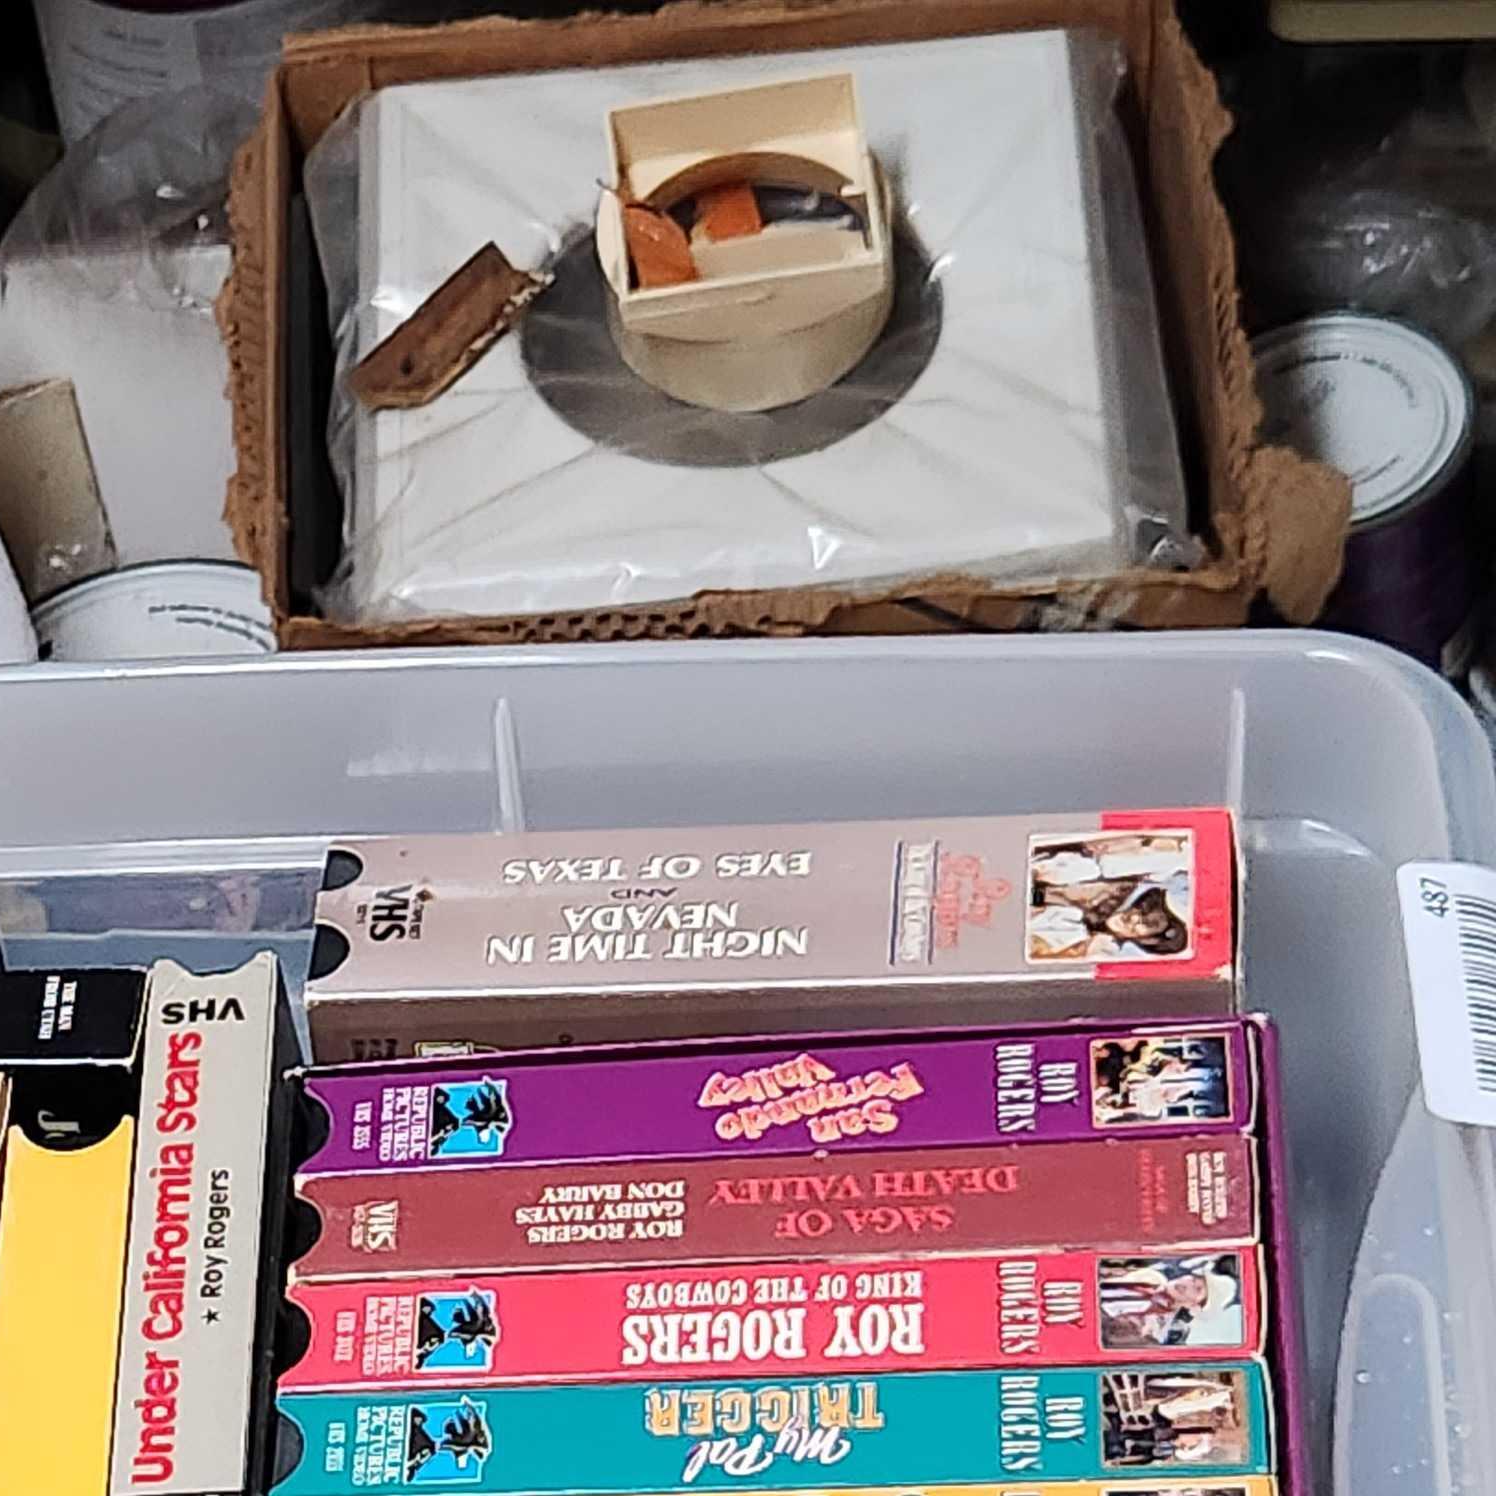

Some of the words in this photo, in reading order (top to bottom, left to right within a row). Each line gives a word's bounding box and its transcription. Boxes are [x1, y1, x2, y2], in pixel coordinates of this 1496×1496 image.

[504, 857, 624, 884] TEXAS
[640, 854, 702, 880] OF
[716, 852, 812, 878] EYES
[610, 886, 678, 900] AND
[1419, 876, 1452, 919] 487
[370, 884, 413, 942] VHS
[561, 902, 739, 932] NEVADA
[486, 934, 536, 965] IN
[548, 932, 657, 963] TIME
[663, 928, 809, 960] NIGHT
[162, 997, 246, 1026] VHS
[155, 1031, 202, 1134] Stars
[697, 1052, 837, 1109] Valley
[995, 1042, 1037, 1133] ROGERS
[1038, 1061, 1080, 1106] ROY
[714, 1061, 925, 1141] Fernando
[806, 1099, 900, 1144] San
[537, 1183, 623, 1204] BARRY
[626, 1180, 686, 1200] DON
[708, 1172, 862, 1205] VALLEY
[872, 1164, 1021, 1198] DEATH
[203, 1169, 231, 1250] Rogers
[515, 1203, 595, 1225] HAYES
[603, 1200, 686, 1220] GABBY
[774, 1208, 834, 1238] OF
[843, 1205, 953, 1234] SAGA
[140, 1142, 195, 1341] California
[527, 1220, 626, 1244] ROGERS
[628, 1219, 685, 1240] ROY
[200, 1254, 229, 1298] Roy
[753, 1276, 809, 1304] THE
[813, 1274, 849, 1302] OF
[854, 1270, 924, 1299] KING
[624, 1279, 749, 1309] COWBOYS
[998, 1260, 1041, 1355] ROGERS
[1042, 1280, 1085, 1329] ROY
[620, 1307, 808, 1366] ROGERS
[823, 1303, 925, 1359] ROY
[130, 1351, 180, 1485] Under
[643, 1381, 886, 1437] TRIGGER
[1000, 1375, 1044, 1472] ROGERS
[1045, 1396, 1087, 1445] ROY
[772, 1413, 852, 1465] My
[681, 1434, 775, 1484] Pal
